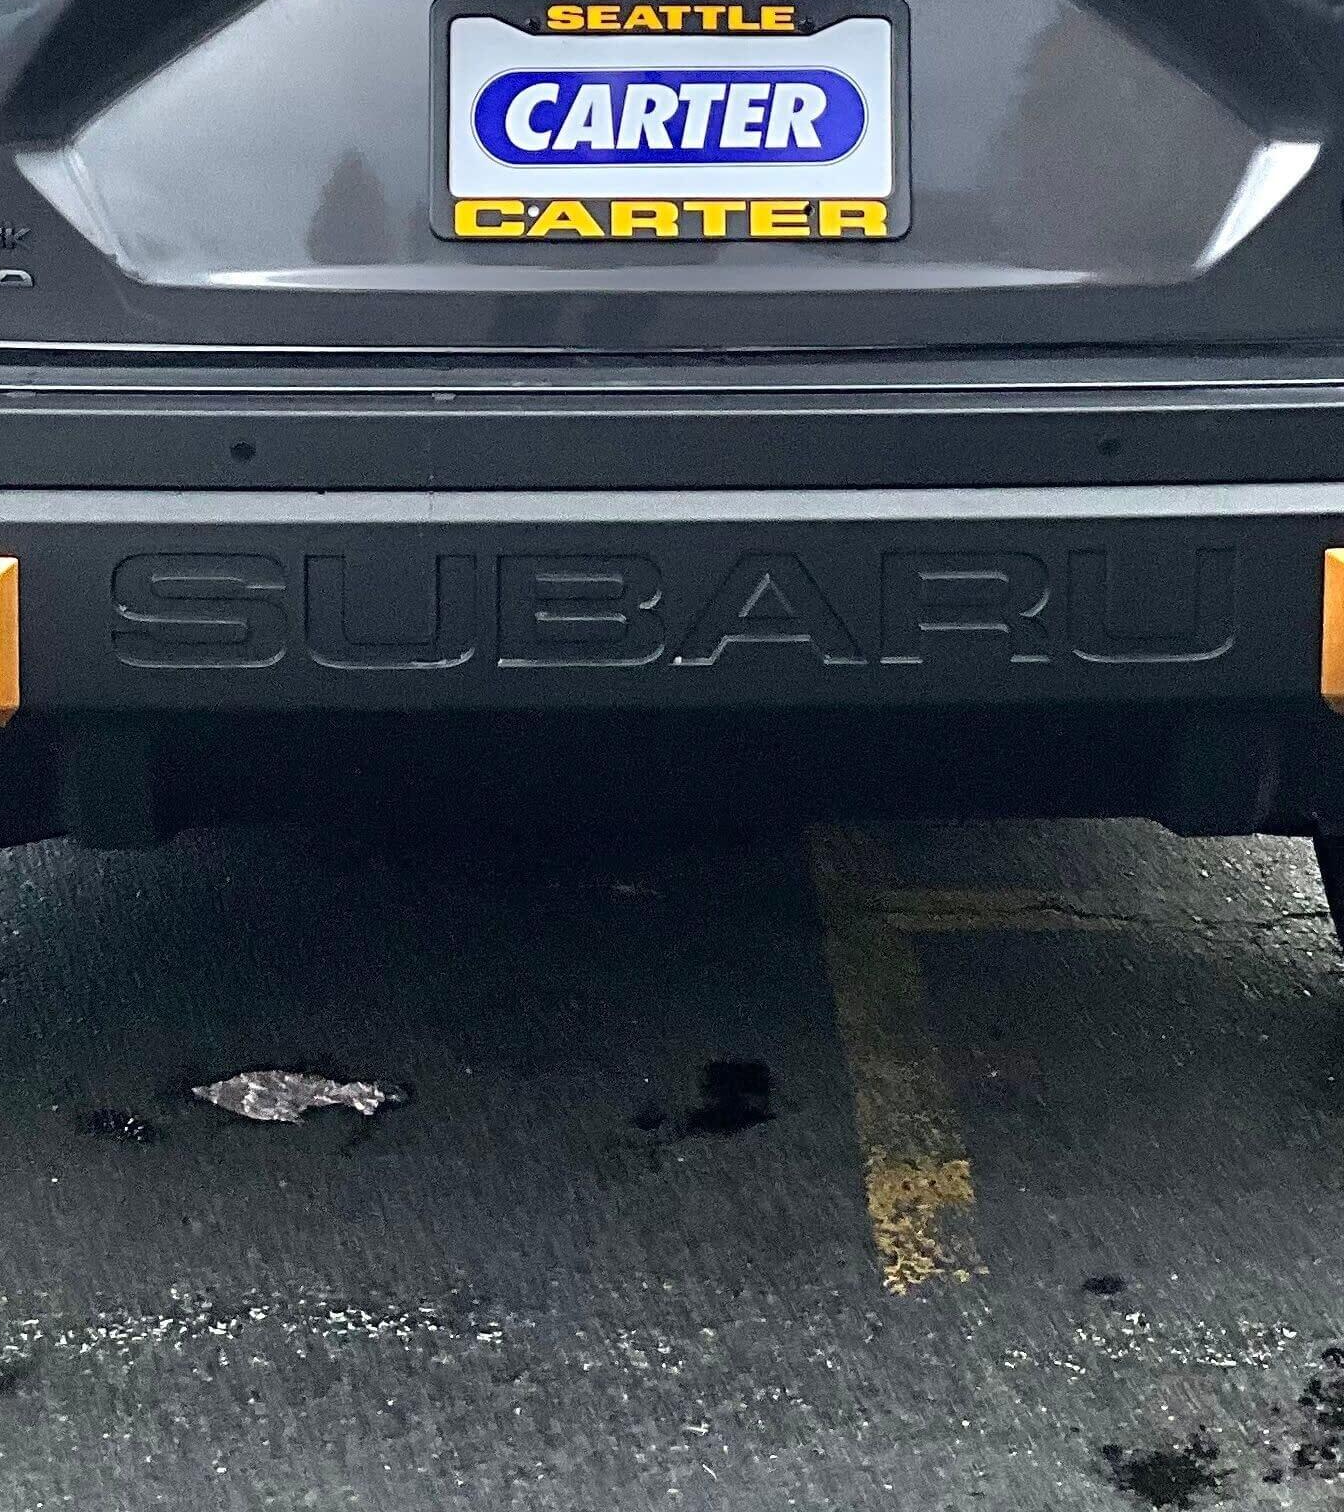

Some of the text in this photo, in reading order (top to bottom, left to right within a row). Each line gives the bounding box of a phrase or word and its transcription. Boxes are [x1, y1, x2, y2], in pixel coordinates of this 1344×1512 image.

[547, 4, 796, 32] SEATTLE
[504, 82, 829, 153] CARTER
[454, 199, 888, 237] CARTER
[109, 549, 1237, 671] SUBARU
